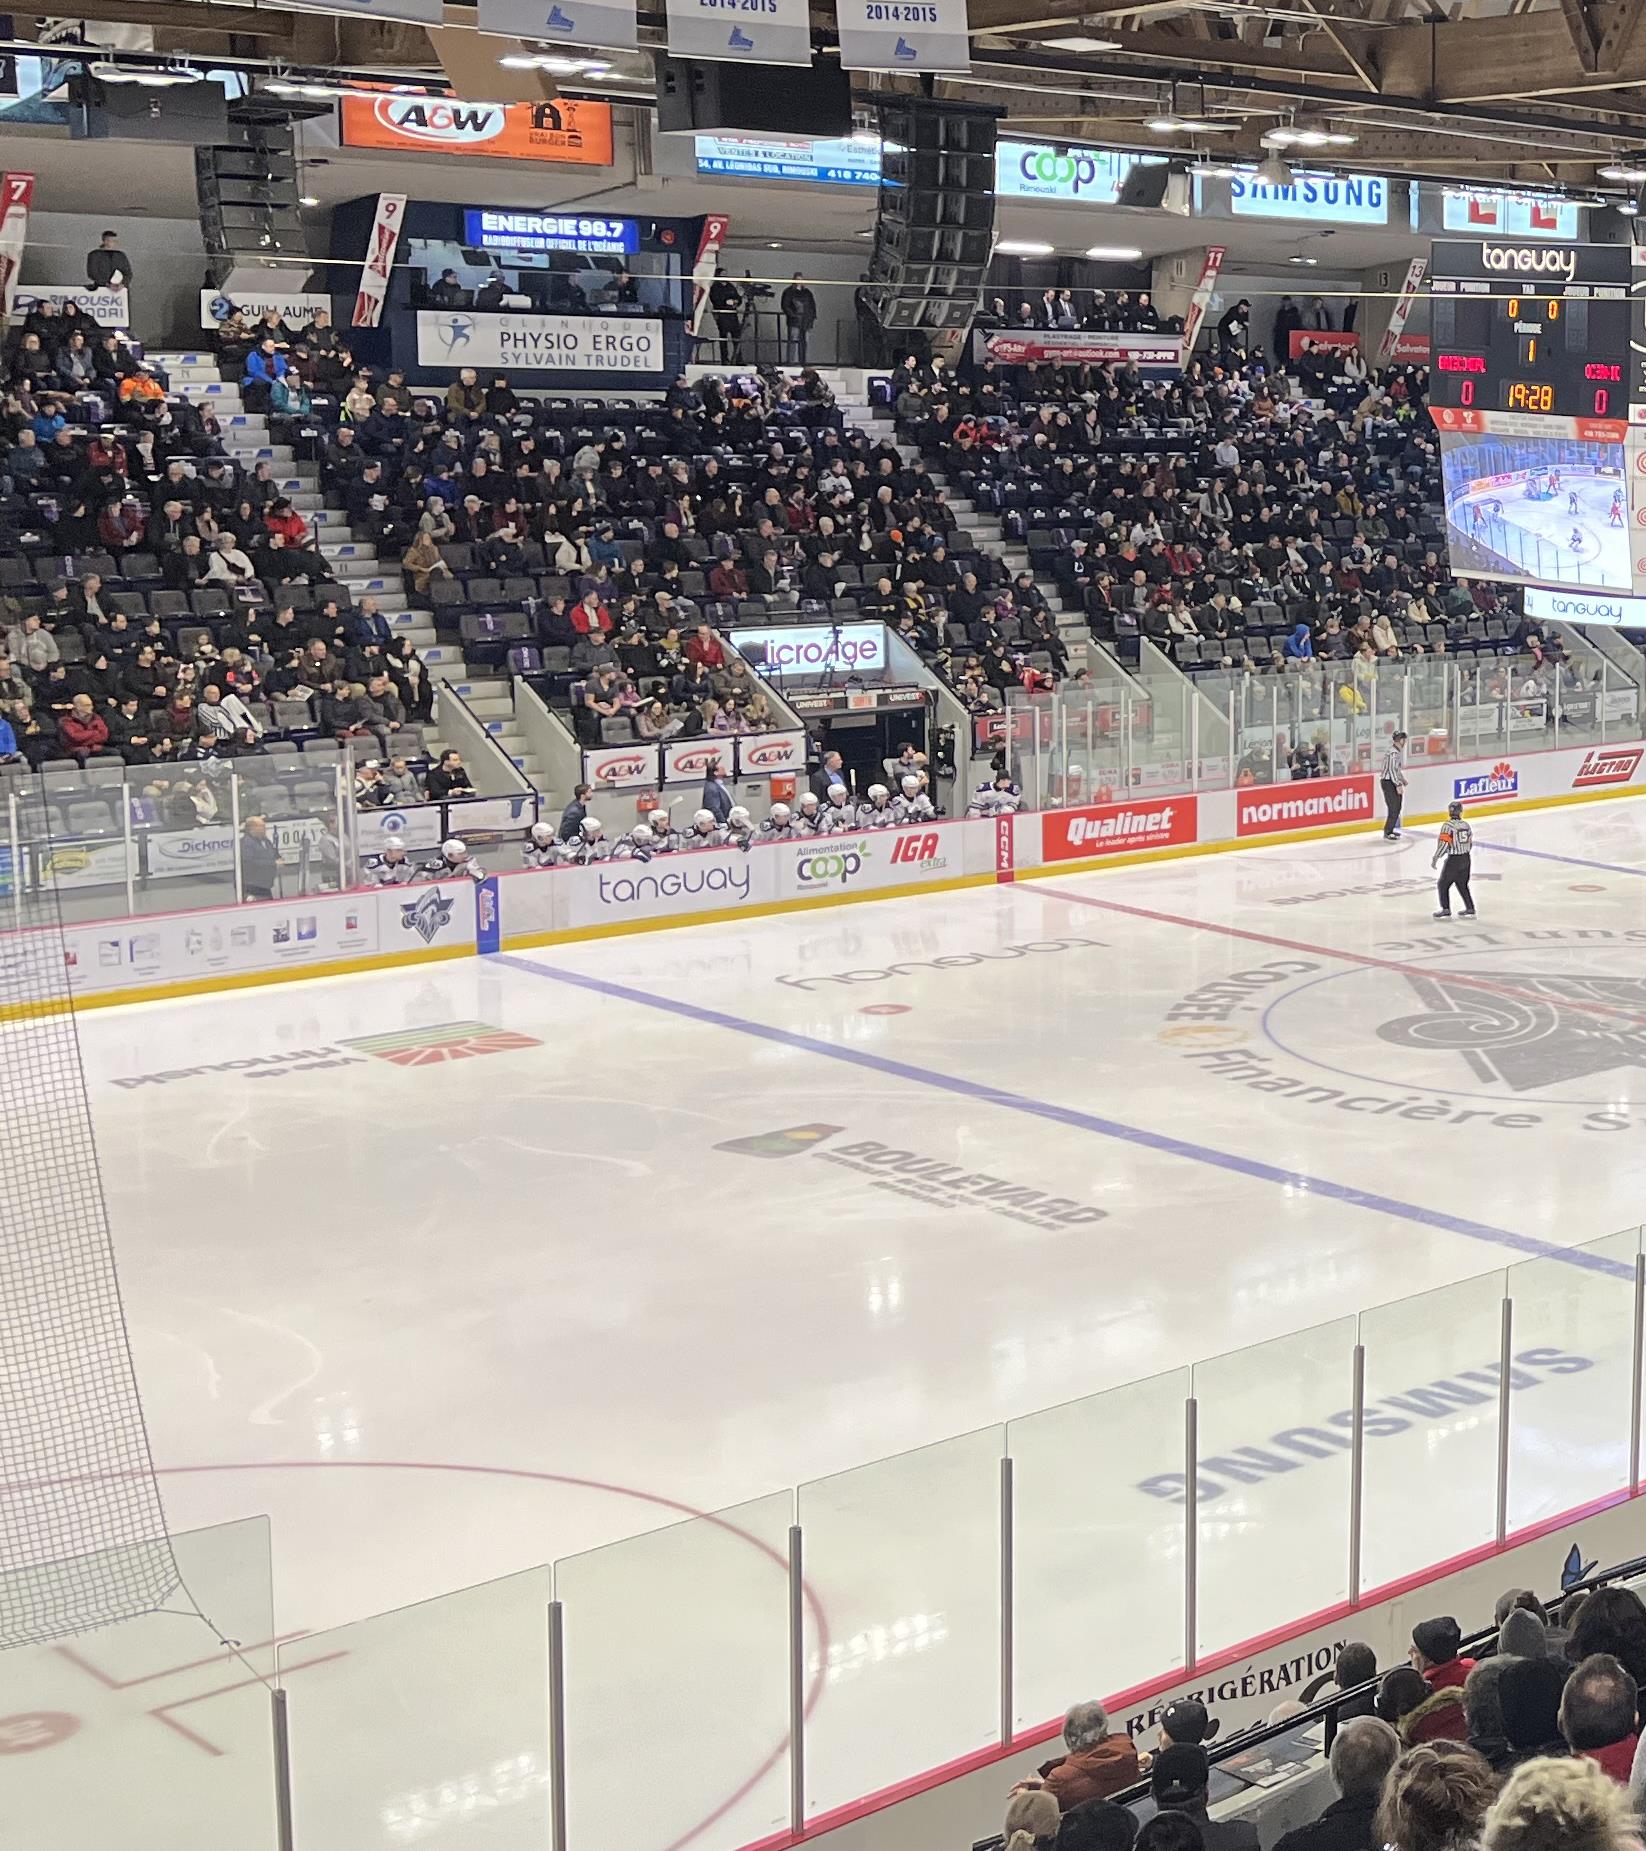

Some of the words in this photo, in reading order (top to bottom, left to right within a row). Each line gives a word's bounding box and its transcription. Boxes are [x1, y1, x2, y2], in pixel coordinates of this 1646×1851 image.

[867, 4, 937, 22] 2014-2015
[397, 105, 494, 131] A&W
[11, 180, 26, 201] 7
[1231, 172, 1382, 207] SAMSUNG
[385, 202, 397, 219] 9
[579, 219, 624, 239] 98.7
[1482, 241, 1576, 282] tanguay
[1508, 298, 1519, 318] 0
[1548, 300, 1559, 320] 0
[500, 332, 578, 351] PHYSIO
[593, 334, 651, 352] ERGO
[501, 352, 576, 367] SYLVAIN
[584, 353, 651, 369] TRUDEL
[1461, 380, 1475, 406] 0
[1508, 383, 1553, 411] 19:28
[1594, 389, 1608, 415] 0
[1551, 596, 1623, 622] tanguay
[1457, 775, 1515, 798] Lafleur
[1242, 789, 1369, 824] normandin
[1066, 807, 1173, 846] Qualinet
[797, 841, 858, 857] Alimentation
[890, 832, 940, 864] IGA
[999, 820, 1009, 870] CCM
[797, 854, 861, 882] coop
[920, 855, 946, 870] extra
[600, 863, 750, 904] tanguay
[1187, 1049, 1536, 1132] Financière
[831, 1141, 1110, 1224] BOULEVARD
[1136, 1346, 1596, 1505] SAMSUNG
[1126, 1638, 1349, 1738] RÉRIGÉRATION
